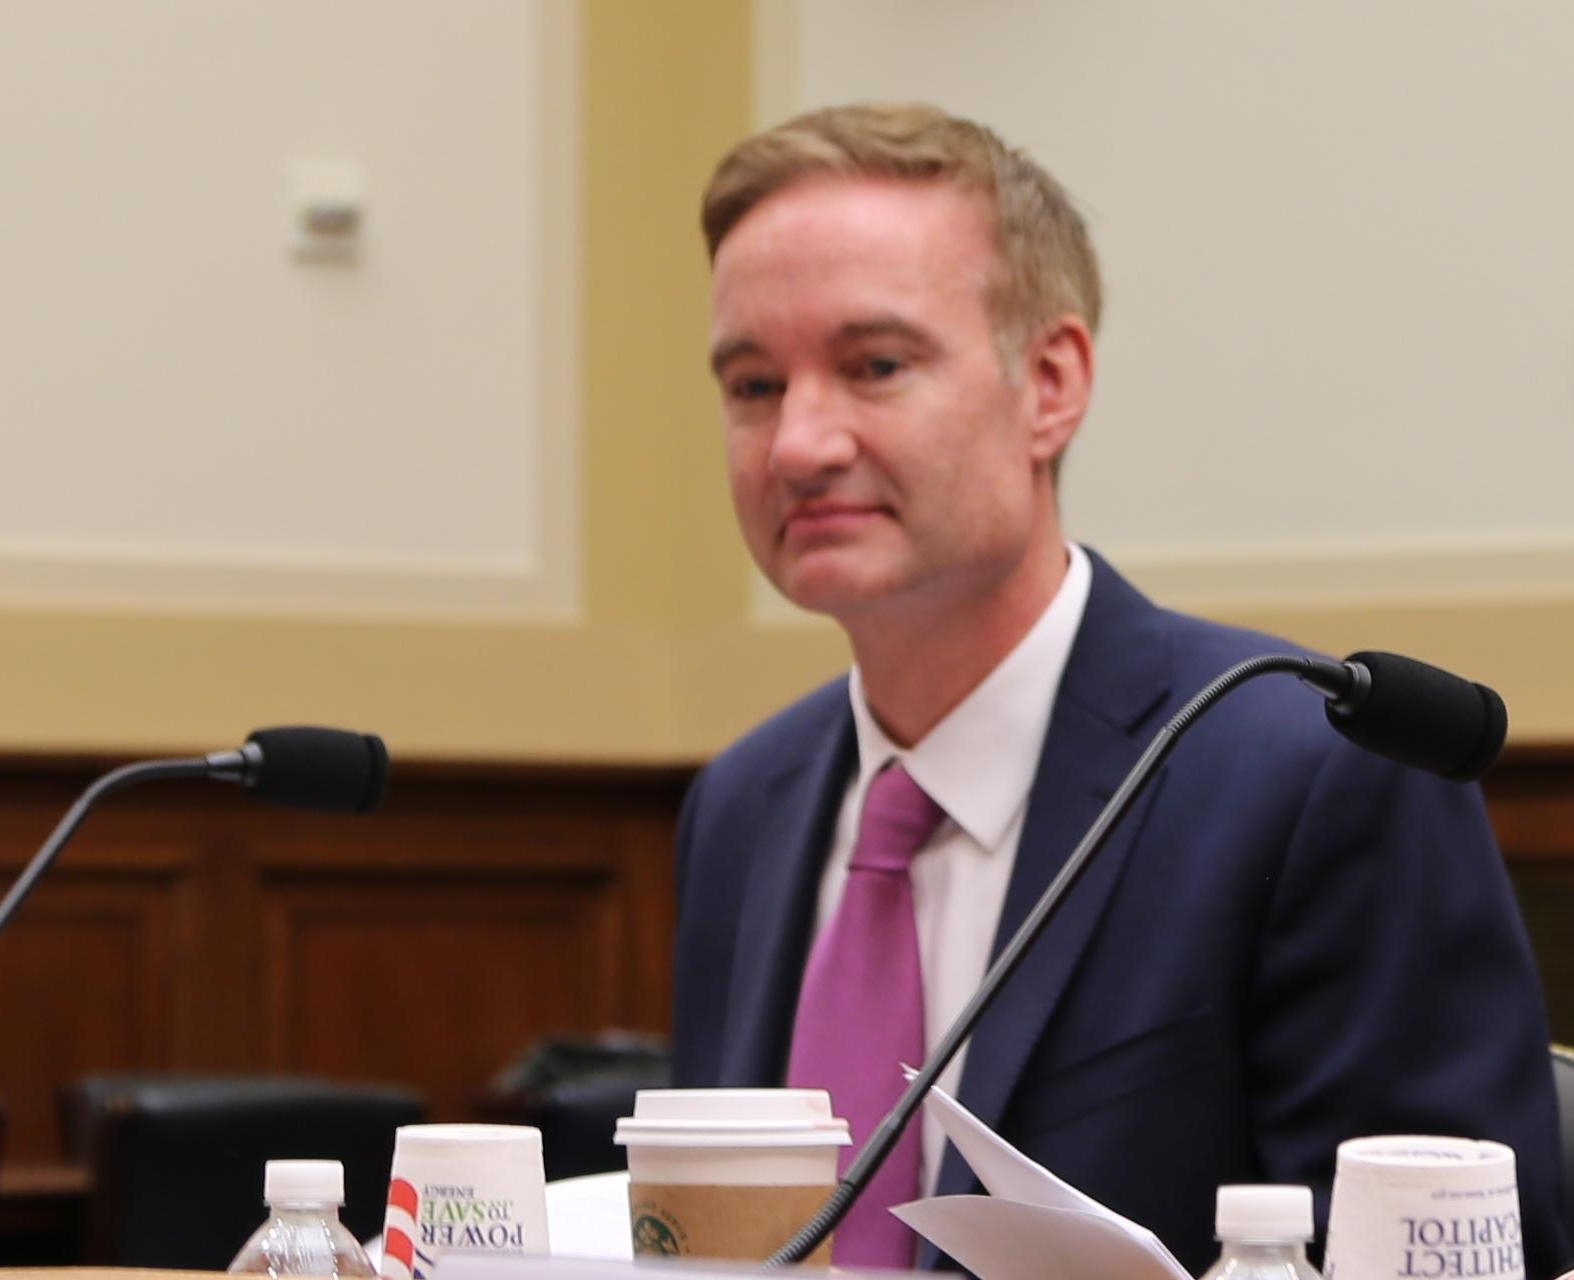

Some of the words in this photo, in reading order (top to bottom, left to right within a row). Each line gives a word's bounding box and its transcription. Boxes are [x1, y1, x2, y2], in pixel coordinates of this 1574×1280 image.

[422, 1200, 486, 1222] SAVE
[421, 1223, 523, 1248] POWER
[1401, 1213, 1521, 1247] CAPITOL
